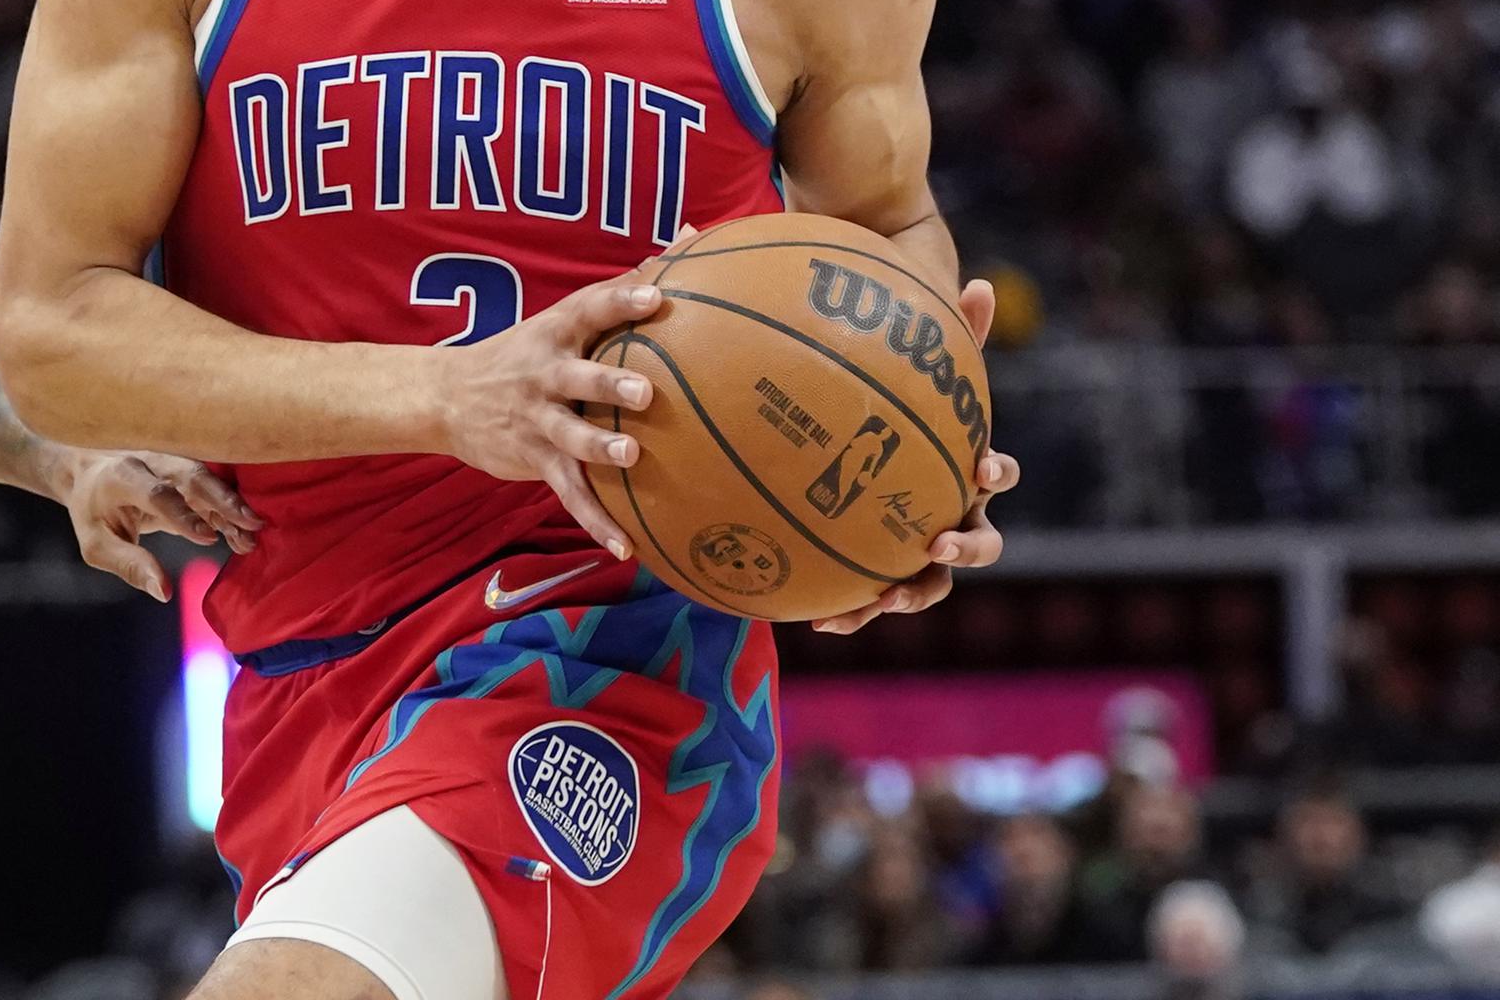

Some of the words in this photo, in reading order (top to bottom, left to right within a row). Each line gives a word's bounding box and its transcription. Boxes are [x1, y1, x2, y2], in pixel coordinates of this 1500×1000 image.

[229, 51, 706, 247] DETROIT
[755, 377, 793, 413] OFFICIAL
[788, 406, 816, 433] GAME
[809, 423, 833, 448] BALL
[809, 258, 988, 476] Wilson
[530, 761, 618, 859] PISTONS
[542, 735, 633, 825] DETROIT
[526, 786, 585, 847] BASKETBALL
[583, 840, 602, 871] CLUB
